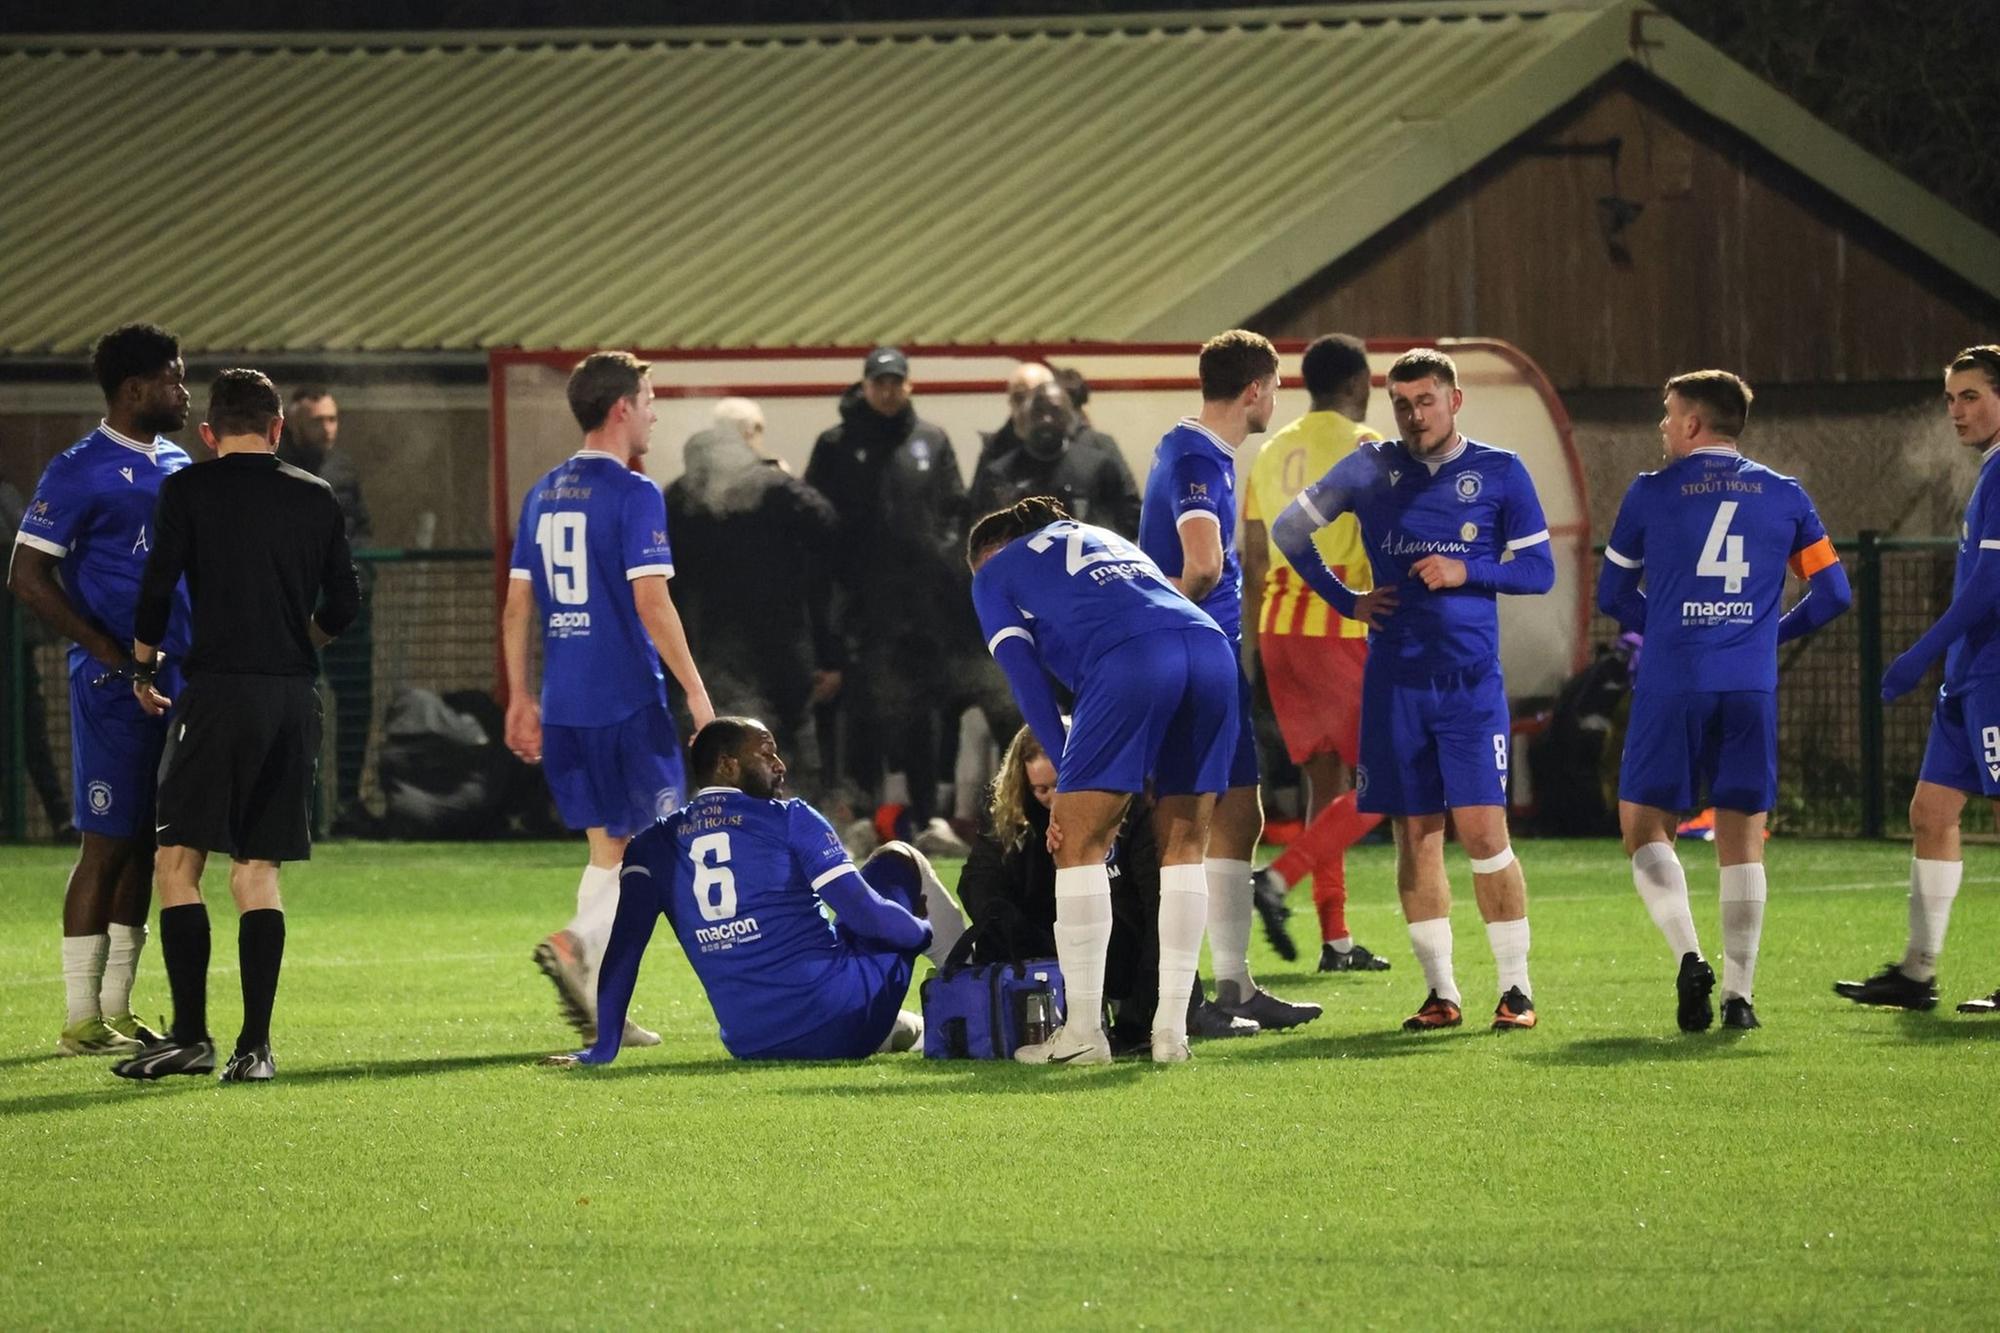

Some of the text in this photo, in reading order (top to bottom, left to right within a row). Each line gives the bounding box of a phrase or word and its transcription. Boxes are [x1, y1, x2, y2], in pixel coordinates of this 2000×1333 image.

[1681, 480, 1763, 496] STOUT HOUSE
[535, 512, 589, 605] 19
[1696, 501, 1750, 593] 4
[1682, 601, 1753, 617] macron
[1493, 734, 1507, 770] 8
[1982, 726, 2000, 763] 9
[704, 815, 743, 829] HOUSE
[688, 831, 738, 922] 6
[695, 917, 759, 944] macron
